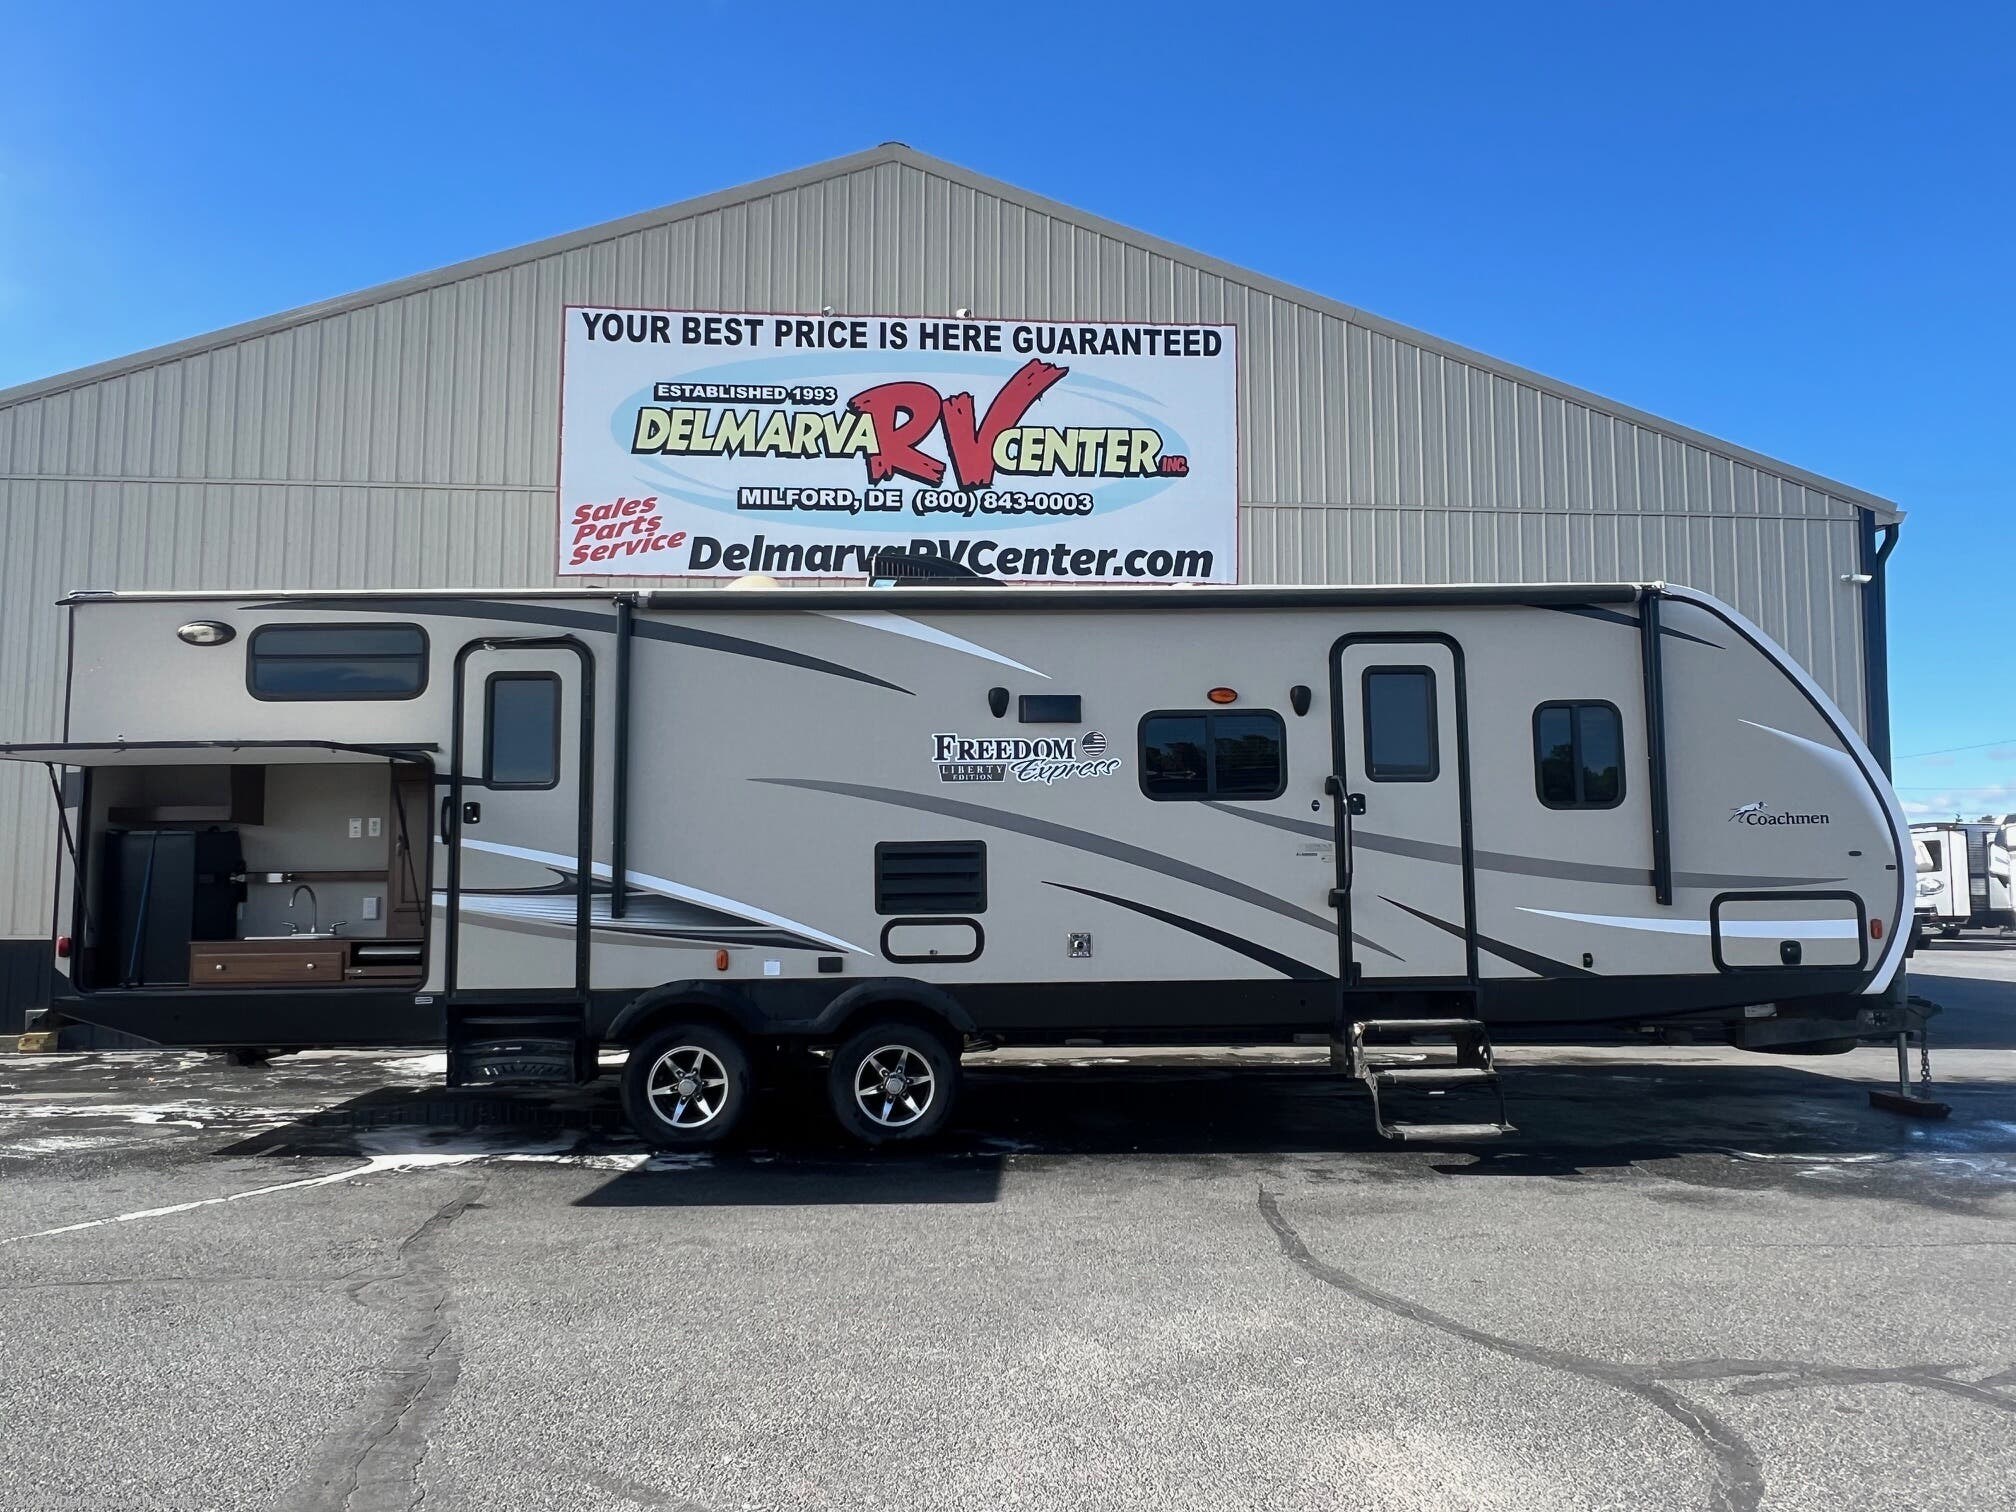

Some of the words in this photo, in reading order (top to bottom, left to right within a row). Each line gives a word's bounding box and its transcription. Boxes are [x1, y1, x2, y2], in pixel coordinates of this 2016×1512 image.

[581, 312, 671, 344] YOUR
[681, 316, 764, 347] BEST
[774, 320, 868, 350] PRICE
[879, 322, 908, 350] IS
[919, 322, 1001, 352] HERE
[1012, 326, 1222, 357] GUARANTEED
[656, 383, 787, 402] ESTABLISHED
[791, 386, 837, 402] 1993
[632, 407, 881, 459] DELMARVA
[848, 358, 1070, 490] RV
[992, 426, 1163, 476] CENTER
[571, 496, 658, 525] Sales
[740, 487, 861, 511] MILFORD,
[872, 490, 902, 512] DE
[913, 490, 976, 514] (800)
[983, 492, 1093, 514] 843-0003
[572, 515, 663, 546] Parts
[568, 531, 687, 566] Service
[942, 764, 1002, 774] LIBERTY
[1010, 757, 1121, 784] Express
[1746, 811, 1830, 826] Coachmen
